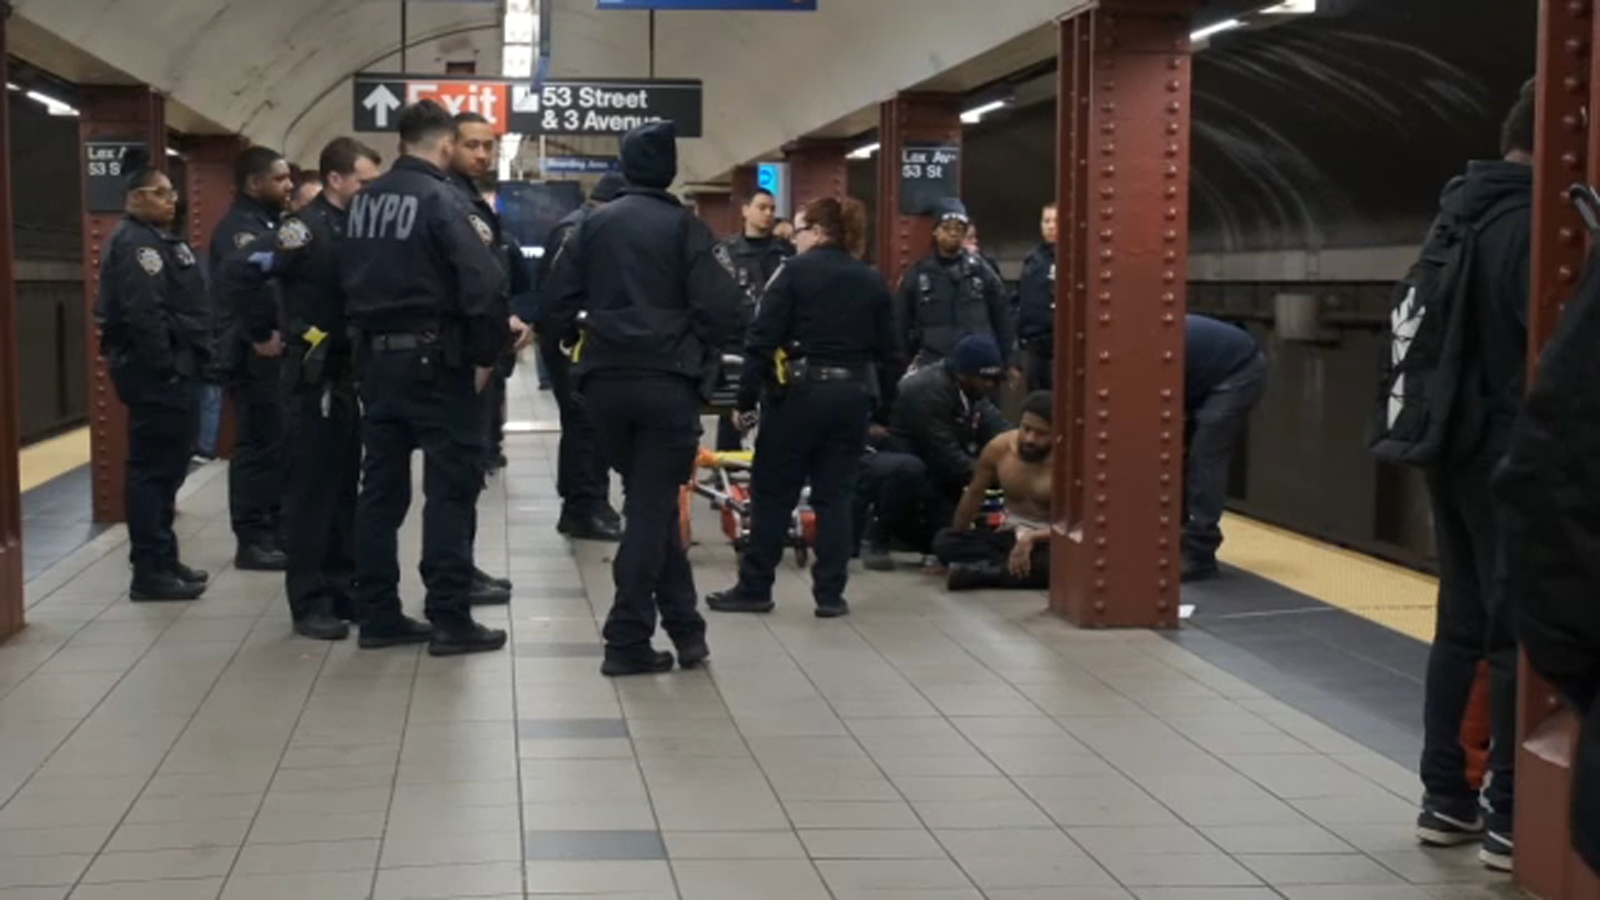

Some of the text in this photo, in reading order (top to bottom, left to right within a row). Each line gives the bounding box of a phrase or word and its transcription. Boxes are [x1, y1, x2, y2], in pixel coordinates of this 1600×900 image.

[541, 86, 648, 109] 53 Street
[541, 109, 559, 130] &
[563, 109, 579, 130] 3
[87, 146, 115, 160] Lex
[901, 150, 928, 163] Lex
[88, 161, 121, 176] 53 S
[902, 164, 943, 178] 53 St
[346, 193, 419, 240] NYPD
